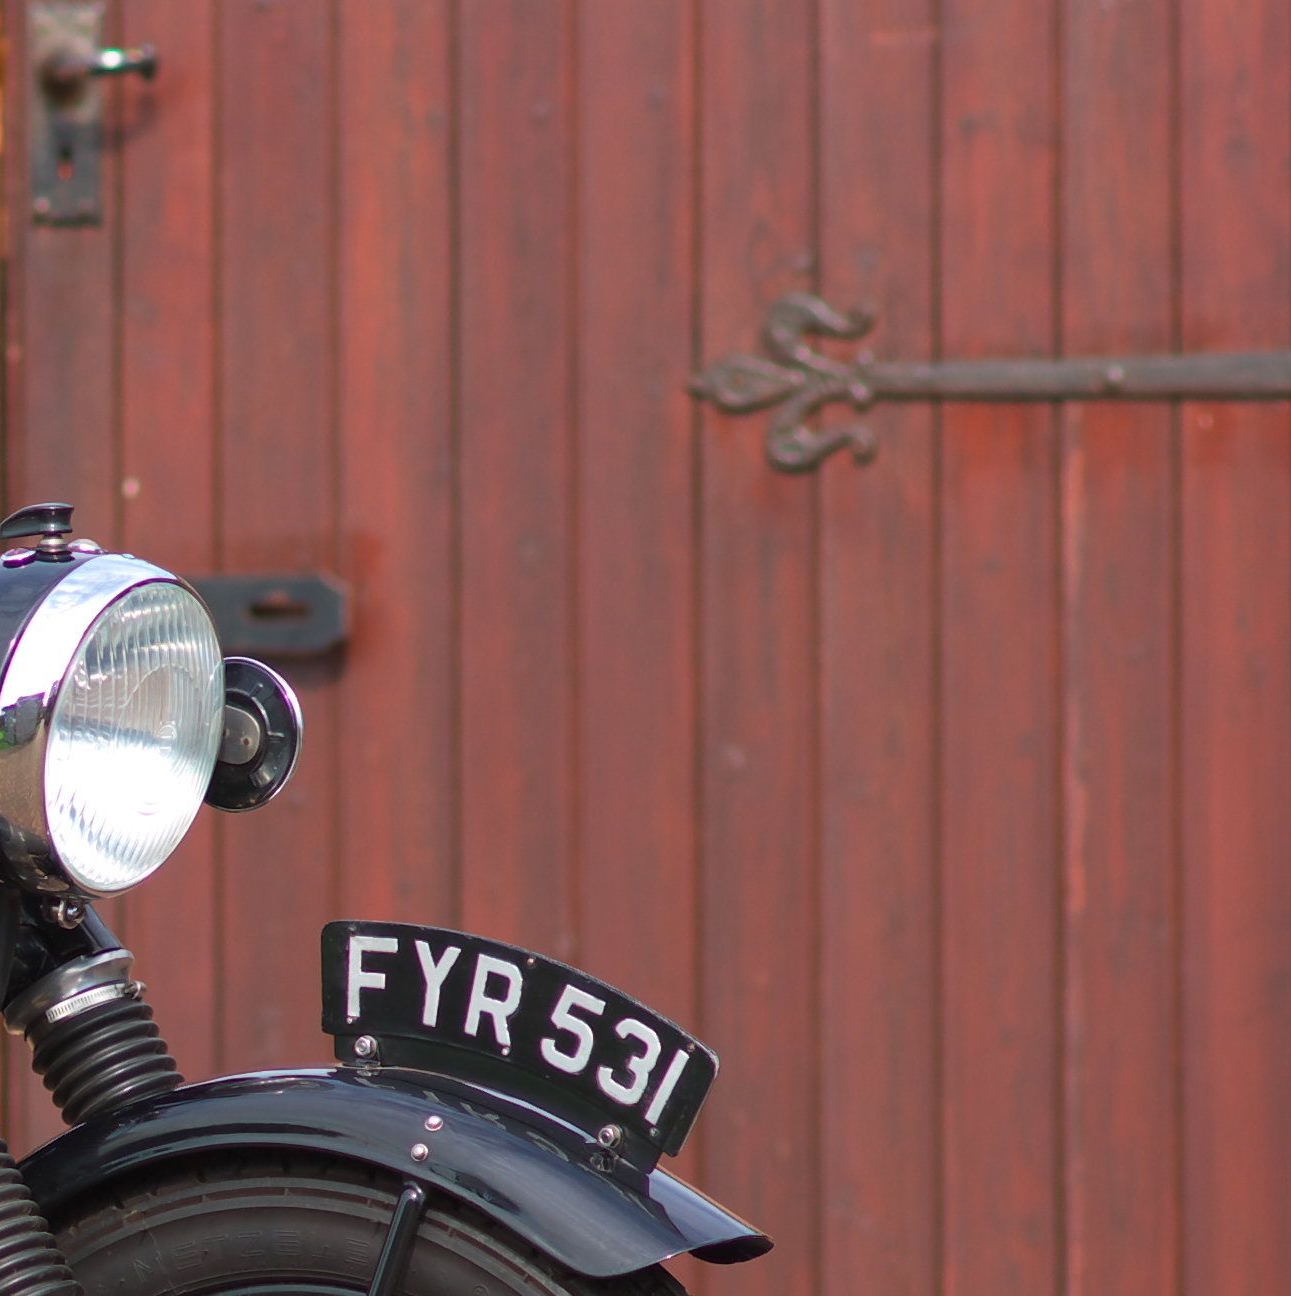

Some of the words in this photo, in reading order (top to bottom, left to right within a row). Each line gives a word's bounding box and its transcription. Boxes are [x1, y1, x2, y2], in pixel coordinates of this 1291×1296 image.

[346, 935, 524, 1048] FYR
[540, 984, 690, 1127] 531
[133, 1230, 371, 1283] METZELE
